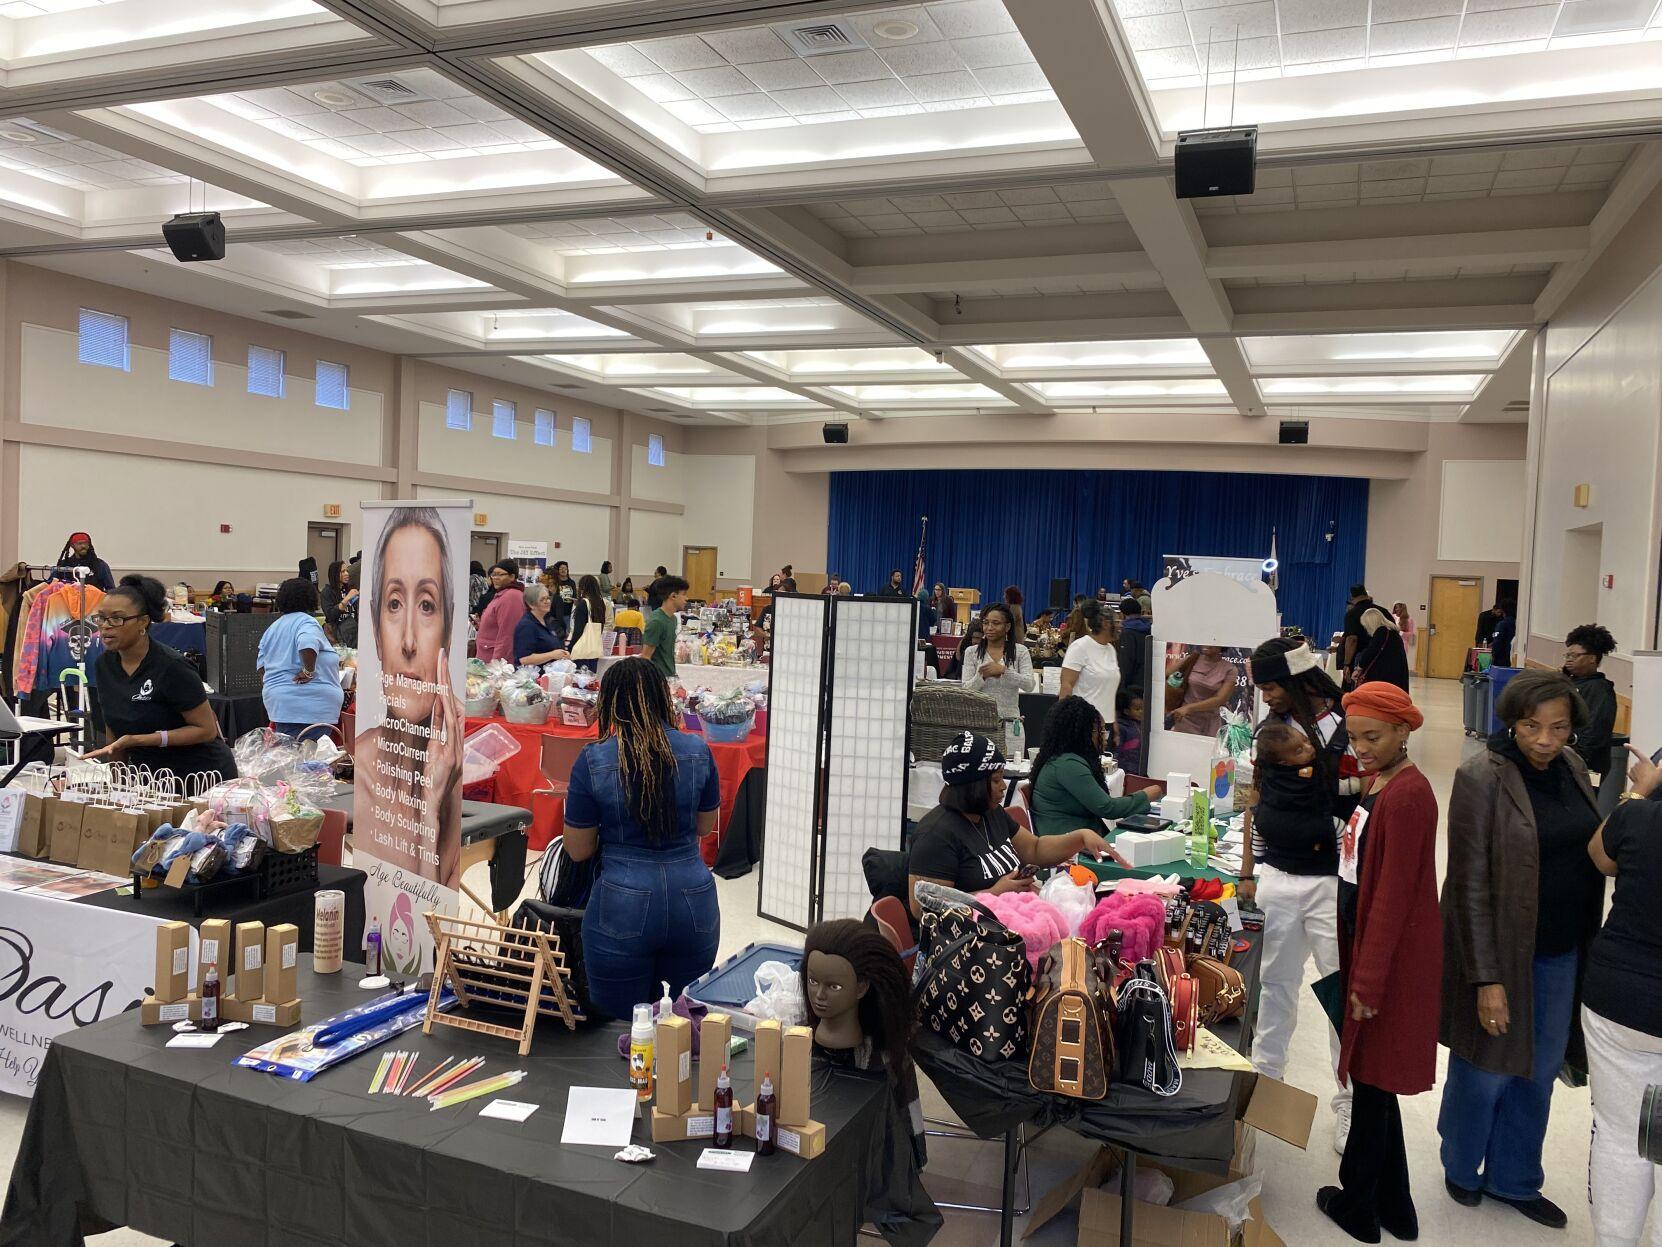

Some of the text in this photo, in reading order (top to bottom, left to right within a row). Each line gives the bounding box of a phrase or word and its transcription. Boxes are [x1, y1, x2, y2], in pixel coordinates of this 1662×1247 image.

[380, 670, 449, 697] Age Management
[379, 690, 407, 709] Facials
[379, 713, 448, 745] MicroChanneling
[377, 736, 429, 763] MicroCurrent
[376, 759, 433, 789] Polishing Peel
[376, 782, 427, 815] Body Waxing
[375, 805, 436, 843] Body Sculpting
[374, 828, 440, 866] Lash Lift & Tints
[370, 862, 441, 910] Age Beautifully
[0, 1024, 52, 1050] WELLNE
